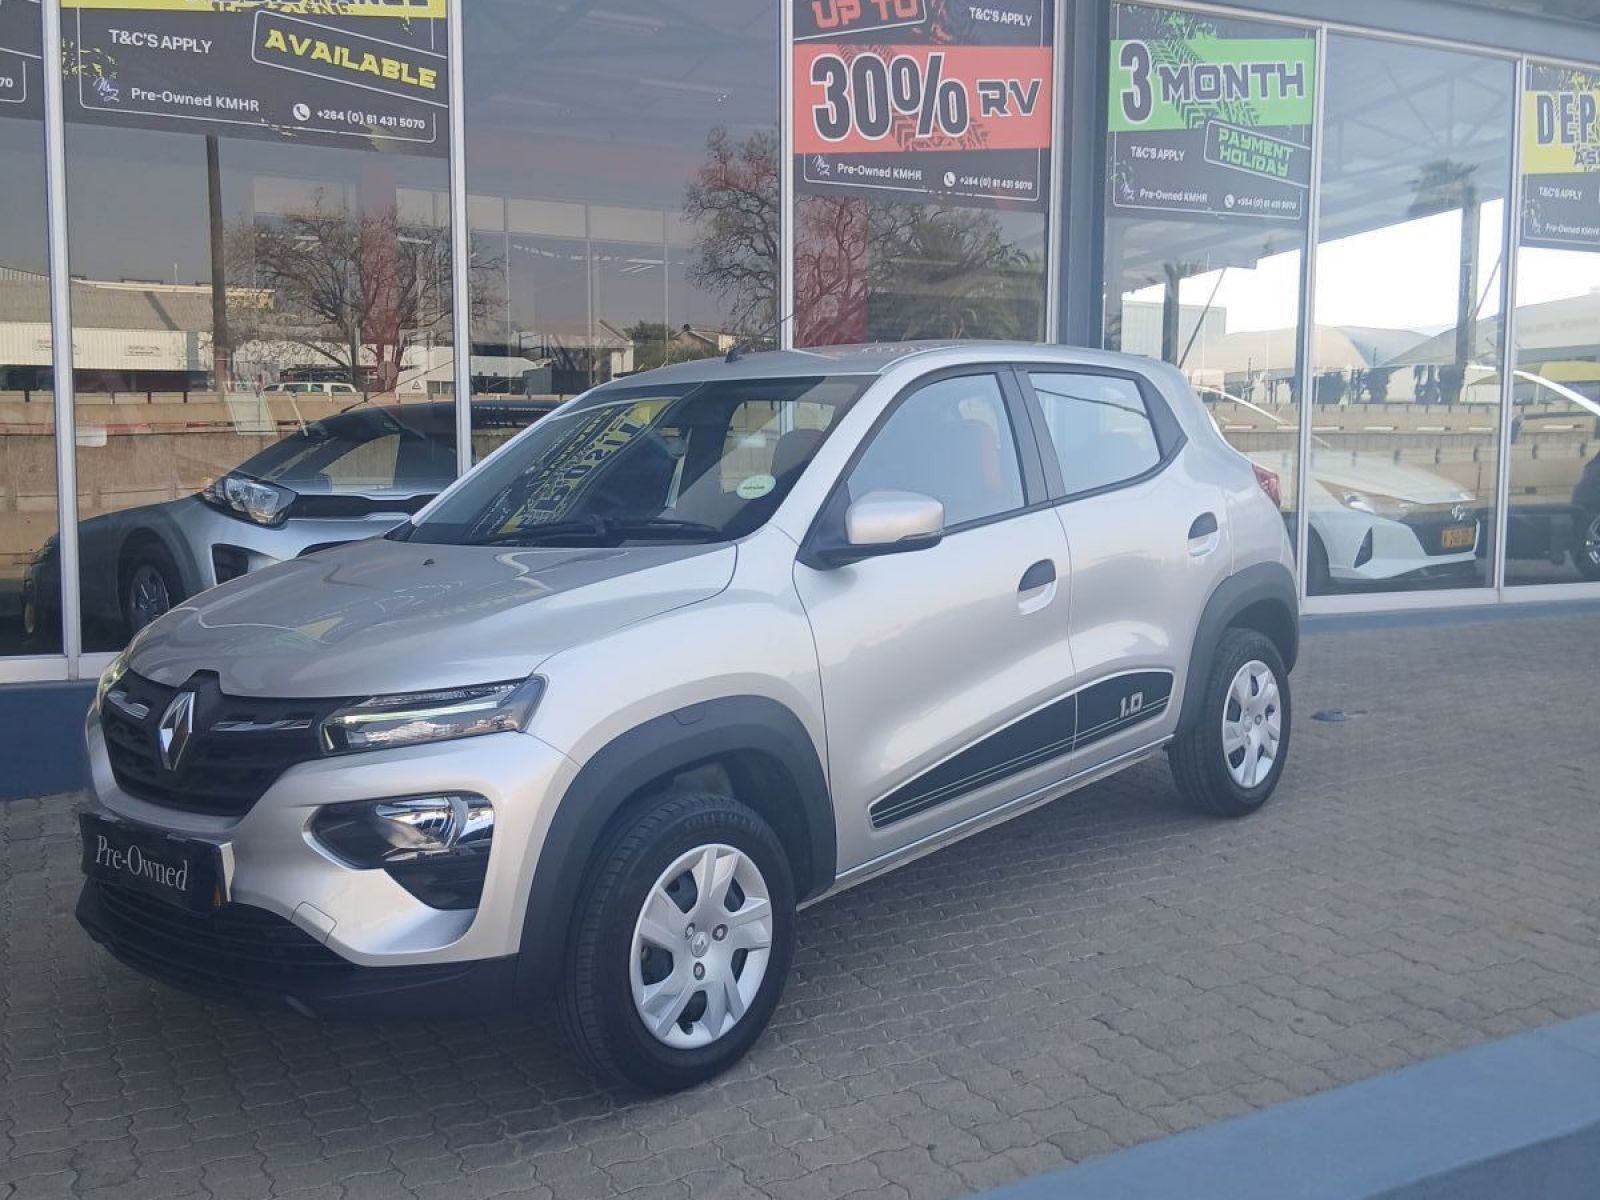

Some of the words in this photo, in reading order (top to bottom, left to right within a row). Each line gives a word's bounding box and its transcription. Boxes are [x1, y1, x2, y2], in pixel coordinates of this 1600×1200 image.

[812, 0, 862, 29] UP
[968, 7, 1001, 23] T&C'S
[1000, 9, 1033, 26] APPLY
[108, 28, 158, 49] T&C'S
[160, 34, 213, 55] APPLY
[264, 29, 436, 89] AVAILABLE
[1120, 40, 1153, 125] 3
[1158, 62, 1305, 102] MONTH
[131, 87, 212, 108] Pre-Owned
[215, 97, 260, 113] KMHR
[811, 53, 970, 142] 30%
[975, 78, 1043, 118] RV
[316, 109, 345, 120] +264
[347, 110, 365, 124] (0)
[379, 116, 398, 127] 431
[400, 117, 426, 130] 5070
[1535, 92, 1600, 148] DEP
[1157, 149, 1185, 162] APPLY
[1218, 127, 1294, 161] PAYMENT
[837, 163, 891, 178] Pre-Owned
[1219, 146, 1290, 177] HOLIDAY
[1120, 692, 1143, 718] 1.0
[95, 835, 189, 891] Pre-Owned
